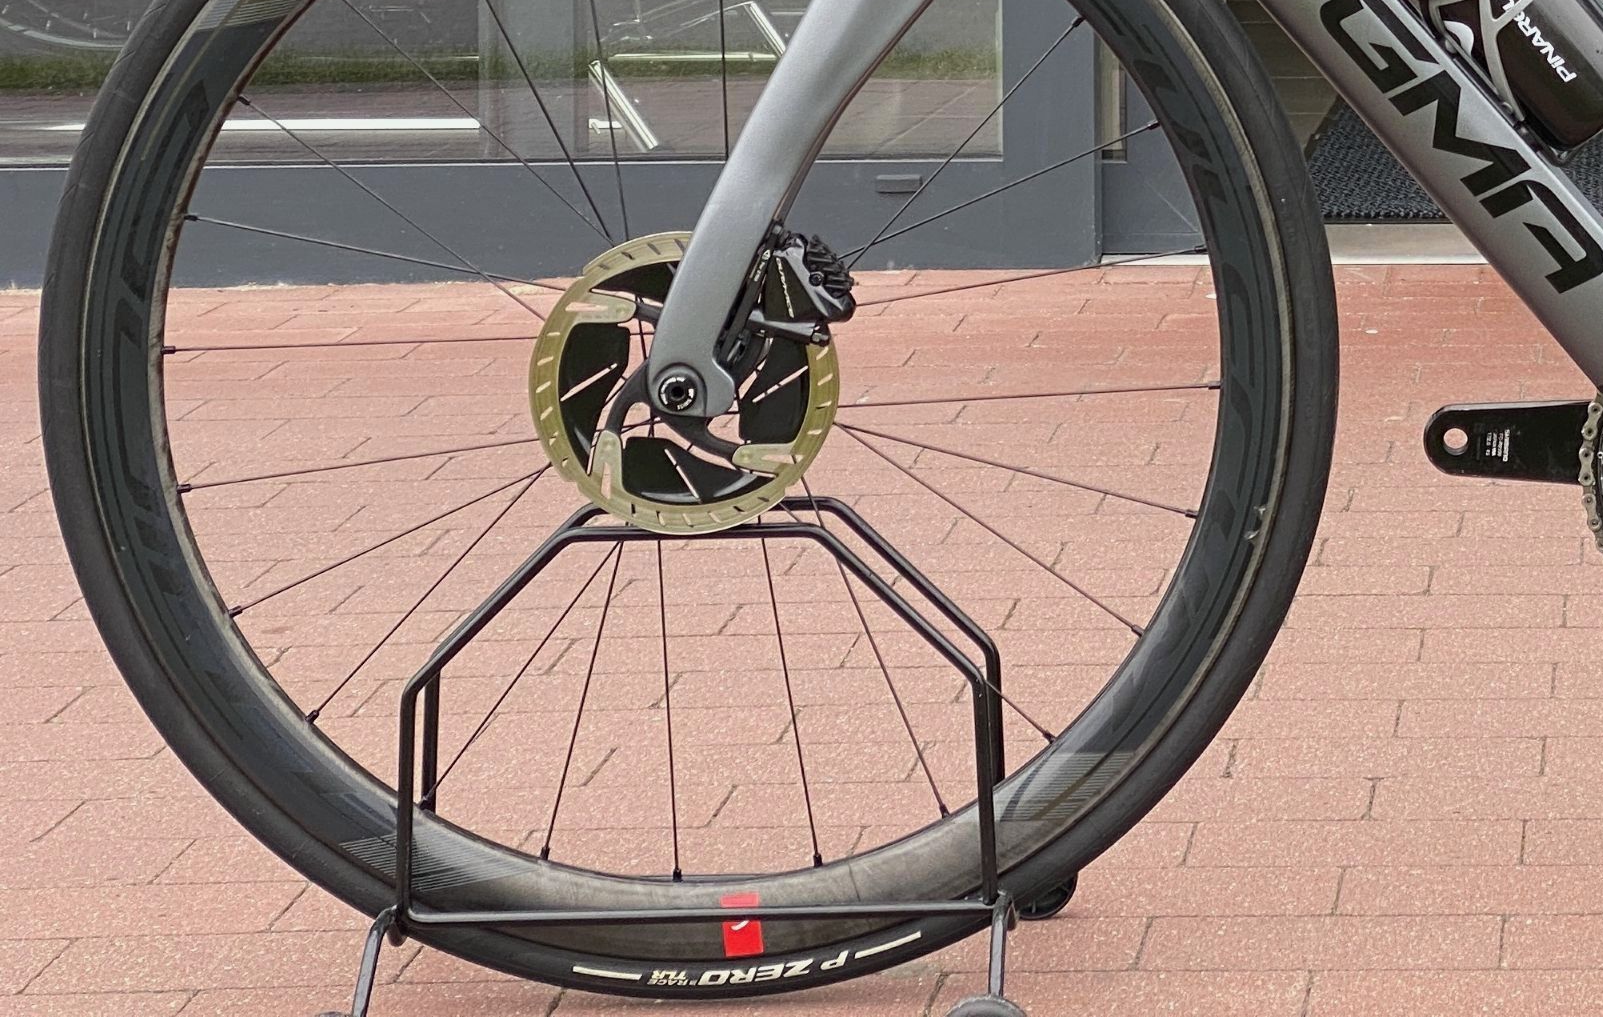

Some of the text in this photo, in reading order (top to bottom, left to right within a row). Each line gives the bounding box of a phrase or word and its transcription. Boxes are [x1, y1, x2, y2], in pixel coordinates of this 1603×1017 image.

[820, 950, 850, 971] P
[651, 969, 688, 980] TLR
[698, 958, 814, 986] ZERO
